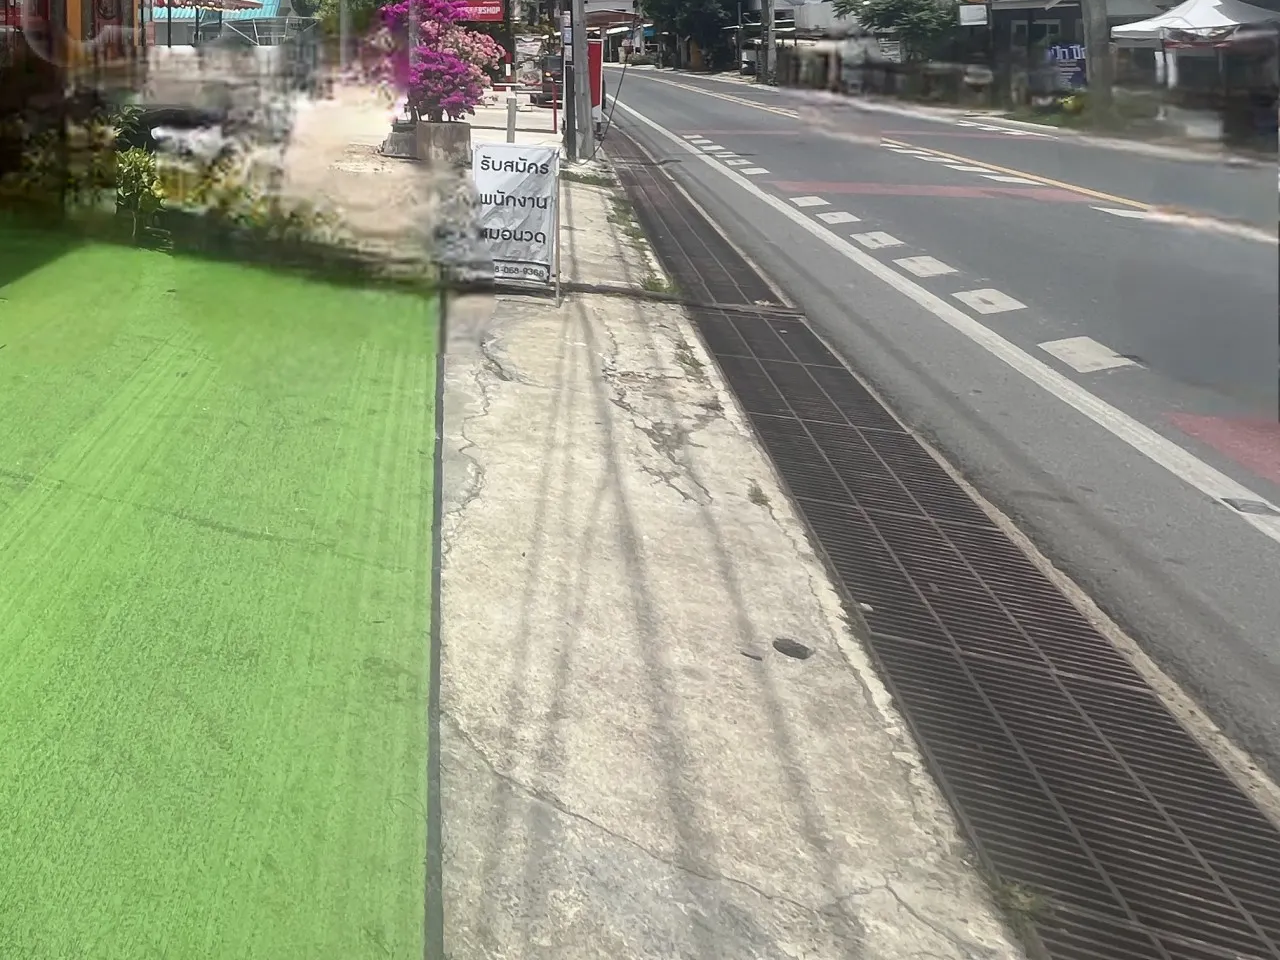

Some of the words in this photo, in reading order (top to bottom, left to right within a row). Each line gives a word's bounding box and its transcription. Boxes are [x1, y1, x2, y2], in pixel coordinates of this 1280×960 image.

[480, 155, 549, 174] รับสมัคร
[480, 189, 547, 209] พนักงาน
